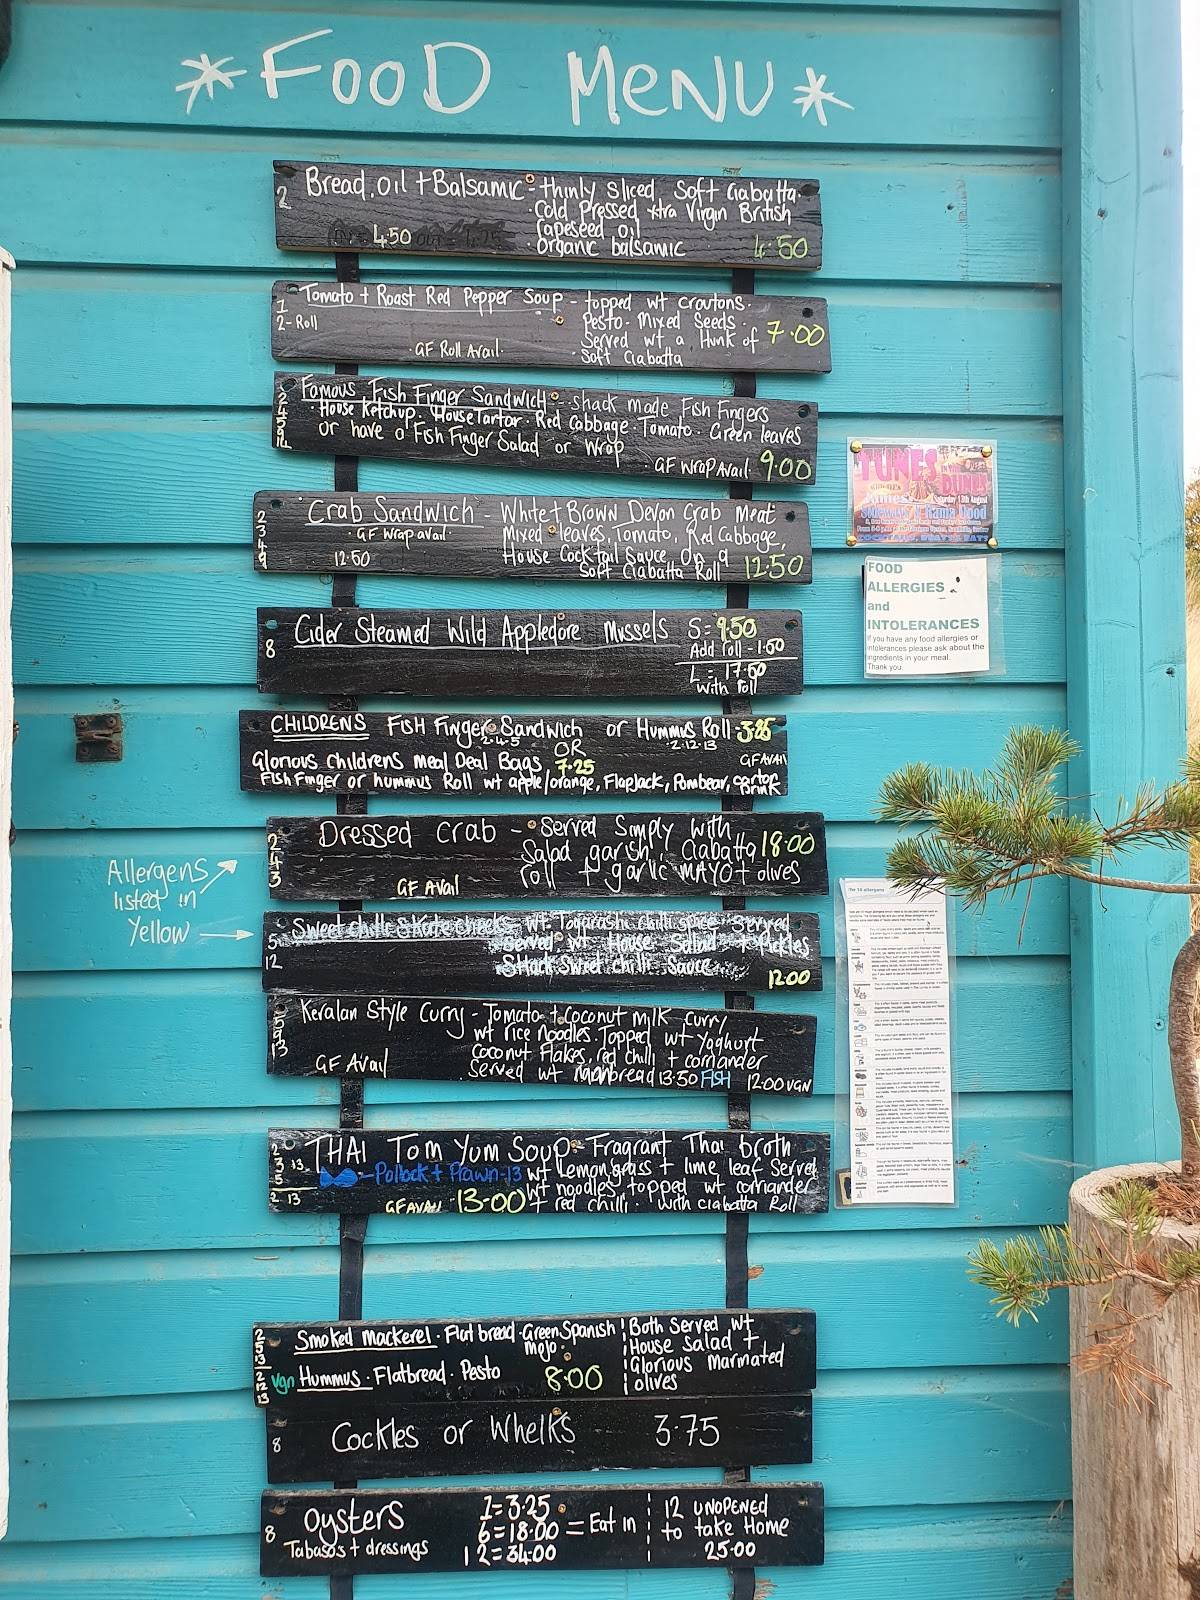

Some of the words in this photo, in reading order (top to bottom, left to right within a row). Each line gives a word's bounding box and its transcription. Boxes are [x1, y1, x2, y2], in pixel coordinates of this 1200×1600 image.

[607, 178, 655, 200] Sliced
[674, 177, 719, 200] Soft
[685, 202, 727, 231] Virgin
[740, 202, 792, 225] British
[618, 220, 641, 238] oil
[611, 236, 686, 258] balsamic
[299, 283, 354, 303] Tomato
[377, 284, 415, 306] Roast
[426, 286, 450, 306] Red
[464, 288, 512, 316] Pepper
[523, 289, 570, 314] Soup
[441, 341, 460, 356] Roll
[581, 349, 611, 365] Soft
[302, 374, 355, 400] Famous
[369, 377, 406, 402] Fish
[413, 384, 465, 410] Finger
[682, 397, 710, 418] Fish
[718, 401, 768, 430] Fingers
[413, 421, 444, 445] Fish
[499, 431, 539, 457] Salad
[761, 426, 801, 445] leaves
[856, 448, 938, 481] TUNES
[308, 497, 363, 523] Crab
[374, 496, 473, 523] Sandwich
[628, 500, 675, 522] Devon
[683, 504, 720, 524] Crab
[503, 549, 550, 565] House
[868, 562, 902, 574] FOOD
[580, 562, 612, 579] Soft
[696, 561, 720, 582] Roll
[868, 581, 944, 592] ALLERGIES
[868, 602, 890, 611] and
[295, 614, 342, 647] Cider
[355, 614, 430, 645] Steamed
[448, 615, 486, 647] Wild
[501, 614, 582, 654] Appledore
[868, 618, 980, 630] INTOLERANCES
[265, 639, 275, 658] 8
[690, 642, 714, 659] Add
[703, 717, 730, 739] Roll
[554, 739, 586, 758] OR
[374, 773, 431, 790] hummus
[443, 772, 472, 790] Roll
[319, 820, 412, 848] Dressed
[522, 839, 571, 864] Salad
[108, 858, 208, 899] Allergens
[114, 888, 161, 911] listed
[128, 916, 190, 947] Yellow
[300, 999, 357, 1024] Keralan
[366, 998, 408, 1031] Style
[586, 1132, 672, 1163] Fragrant
[682, 1132, 724, 1154] Thai
[739, 1133, 790, 1157] broth
[770, 1196, 798, 1212] Roll
[297, 1327, 353, 1350] Smoked
[628, 1316, 664, 1337] Both
[629, 1338, 674, 1356] House
[299, 1364, 361, 1387] Hummus
[460, 1355, 500, 1380] Pesto
[332, 1417, 419, 1452] Cockles
[590, 1506, 616, 1533] Eat
[622, 1512, 636, 1533] in
[664, 1496, 684, 1520] 12
[661, 1524, 682, 1542] to
[694, 1518, 734, 1537] take
